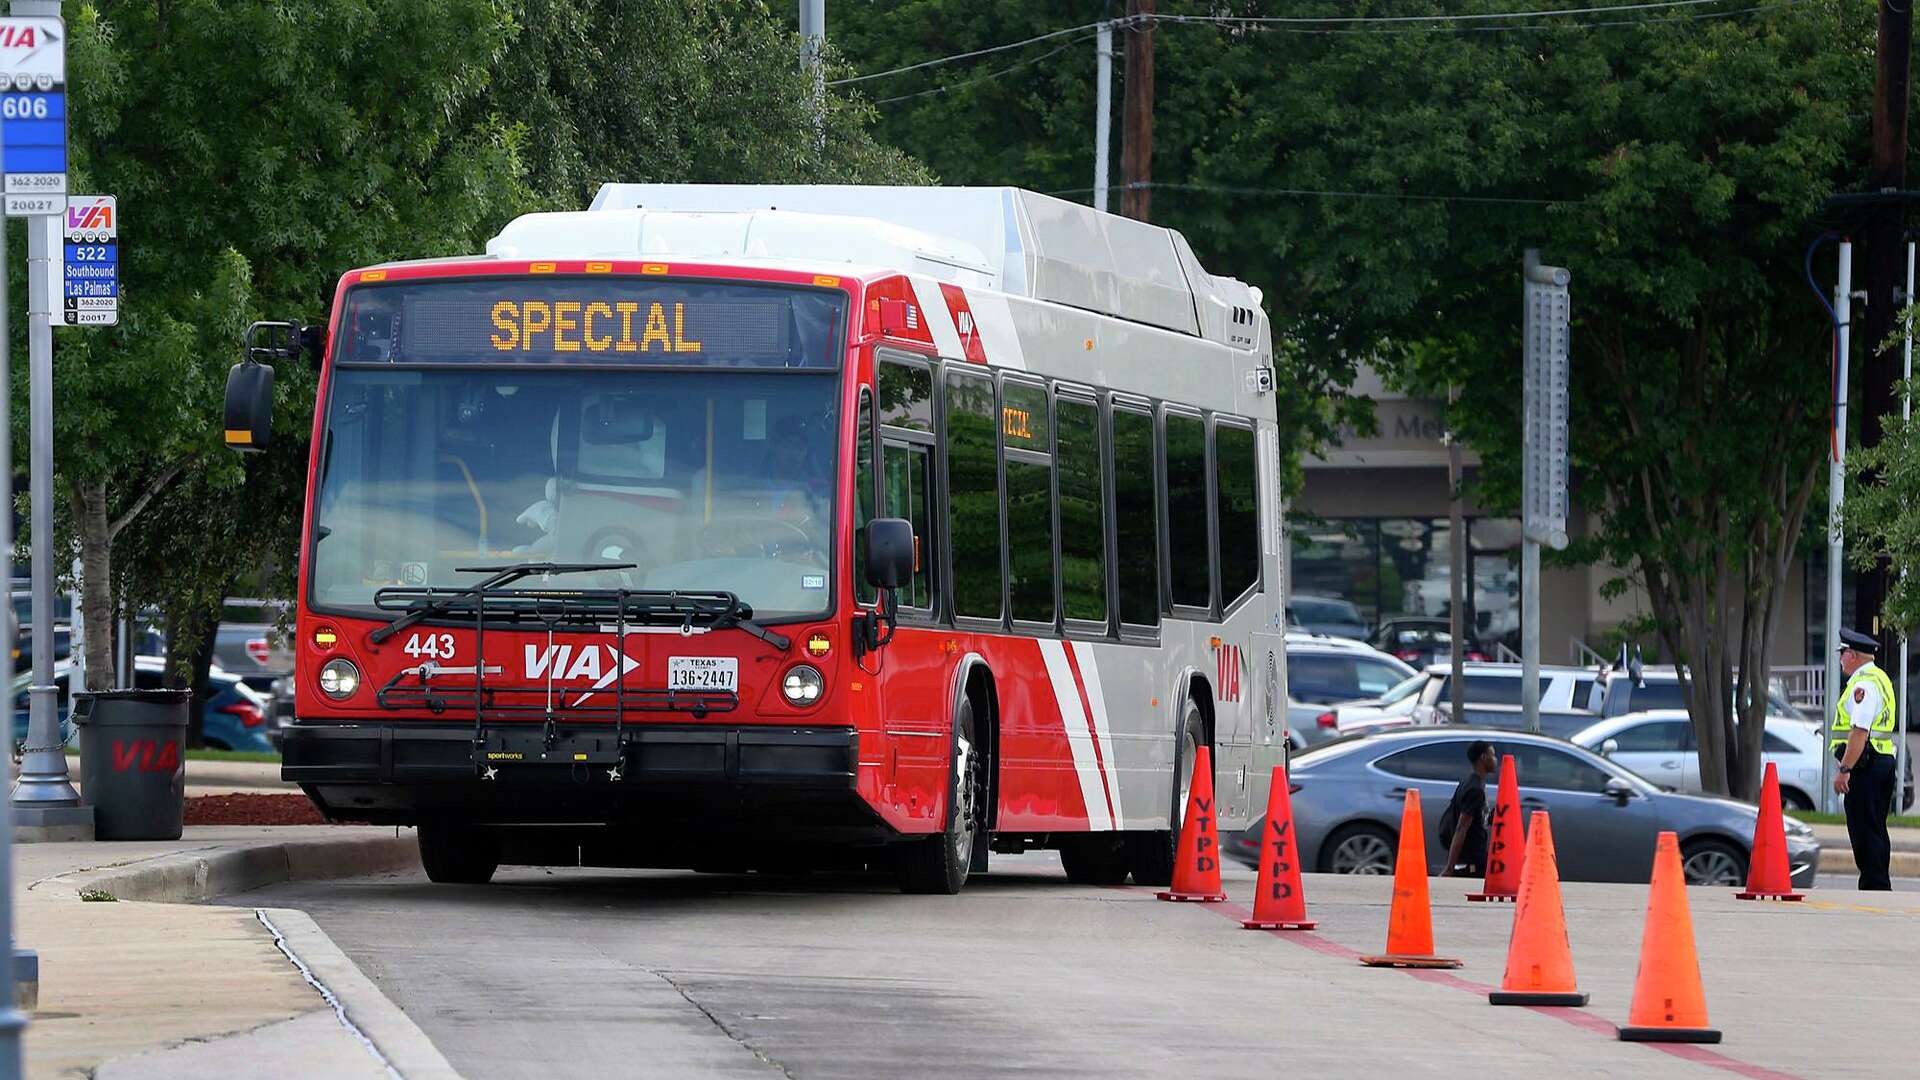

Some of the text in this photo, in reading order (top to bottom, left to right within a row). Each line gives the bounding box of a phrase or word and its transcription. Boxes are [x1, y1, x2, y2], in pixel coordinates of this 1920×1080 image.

[3, 97, 47, 119] 606
[11, 177, 60, 186] 362-2020
[11, 200, 52, 210] 20027
[76, 247, 106, 261] 522
[66, 265, 115, 277] Southbound
[65, 281, 115, 296] "Las Palmas"
[81, 297, 113, 306] 362-2020
[490, 301, 701, 352] SPECIAL
[404, 633, 456, 659] 443
[525, 644, 601, 680] VIA
[689, 659, 717, 667] TEXAS
[1216, 643, 1240, 703] VIA
[112, 739, 177, 771] VIA
[487, 752, 523, 761] sportworks
[1195, 797, 1215, 873] VTPD
[1490, 803, 1510, 875] VTPD
[1271, 819, 1293, 899] VTPD
